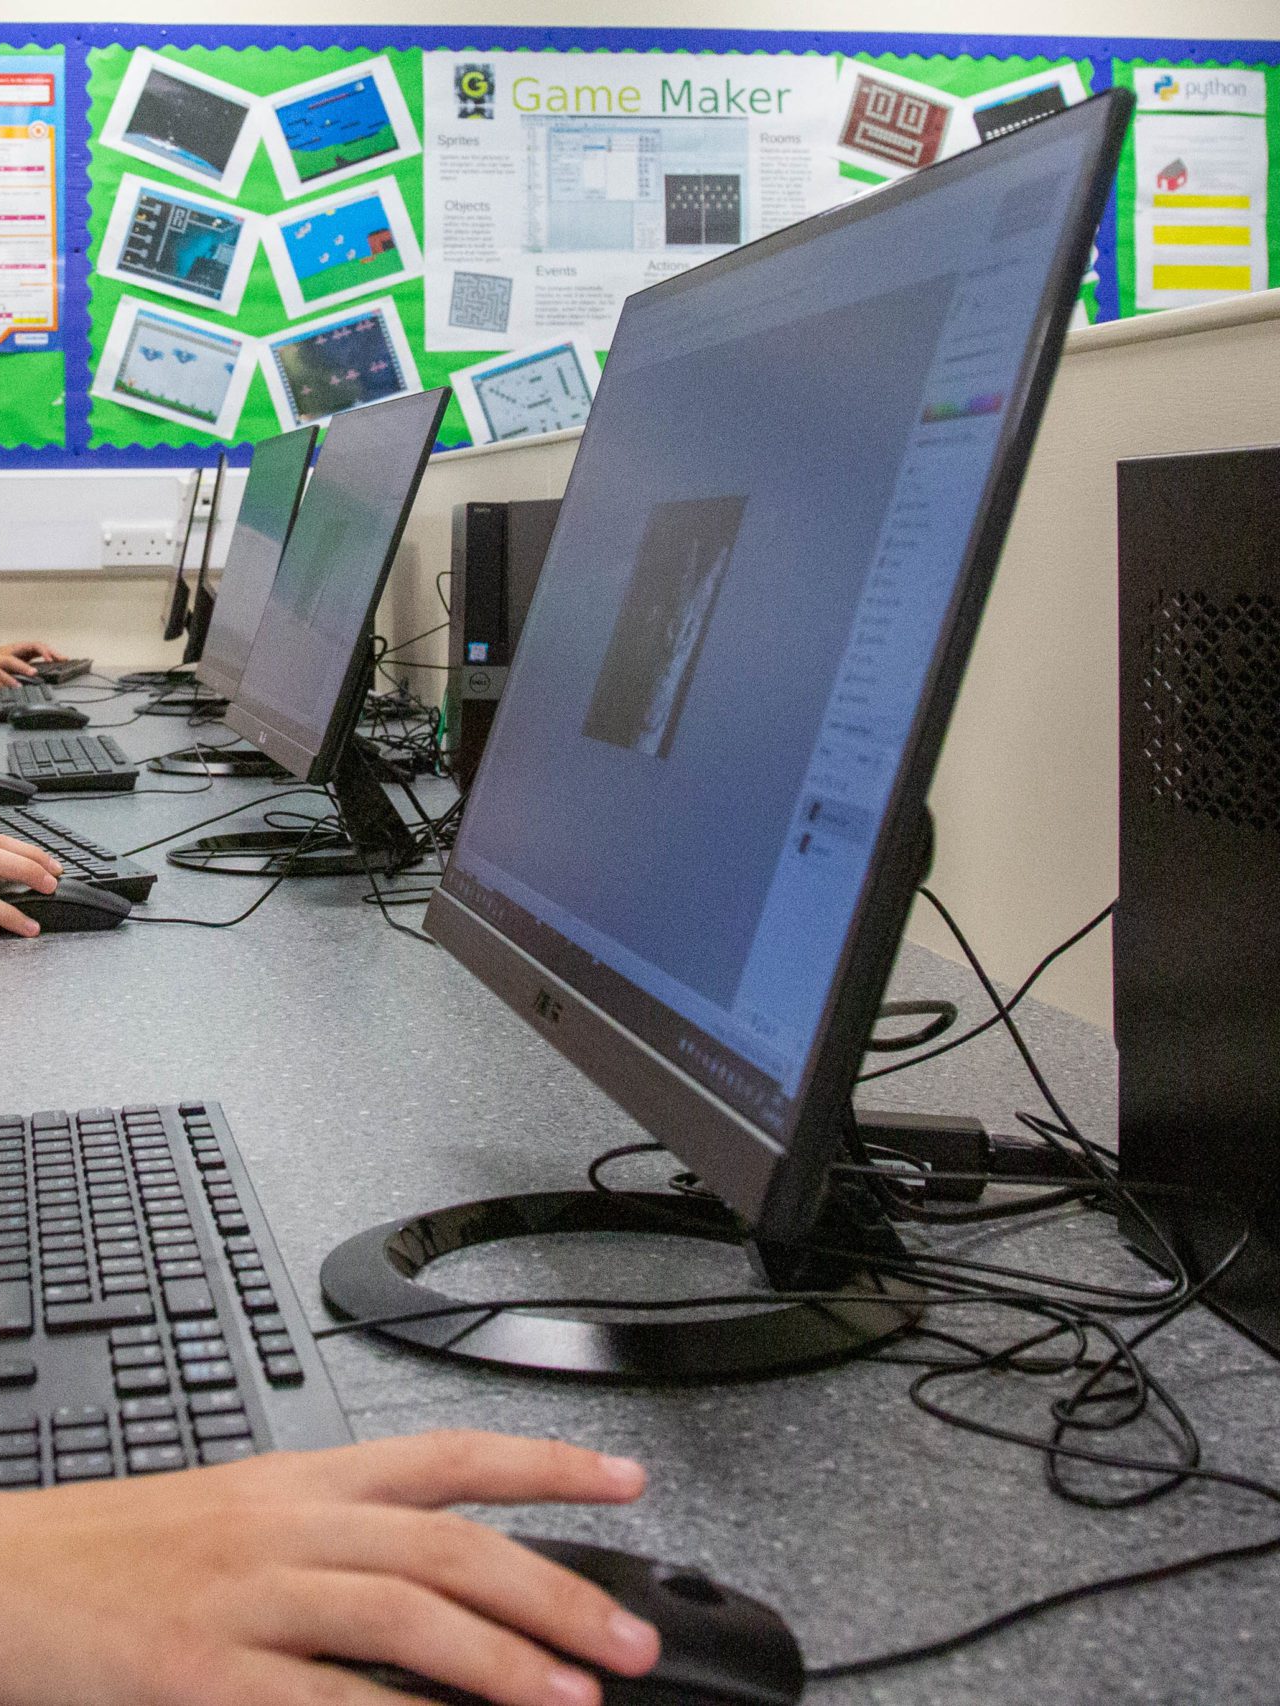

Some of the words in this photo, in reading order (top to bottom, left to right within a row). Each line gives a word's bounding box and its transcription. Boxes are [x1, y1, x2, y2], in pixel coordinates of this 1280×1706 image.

[511, 76, 642, 113] Game
[660, 78, 793, 115] Maker
[1185, 77, 1248, 100] python
[437, 134, 480, 148] Sprites
[759, 132, 802, 144] Rooms
[444, 200, 491, 214] Objects
[535, 264, 578, 277] Events
[646, 259, 690, 272] Actions
